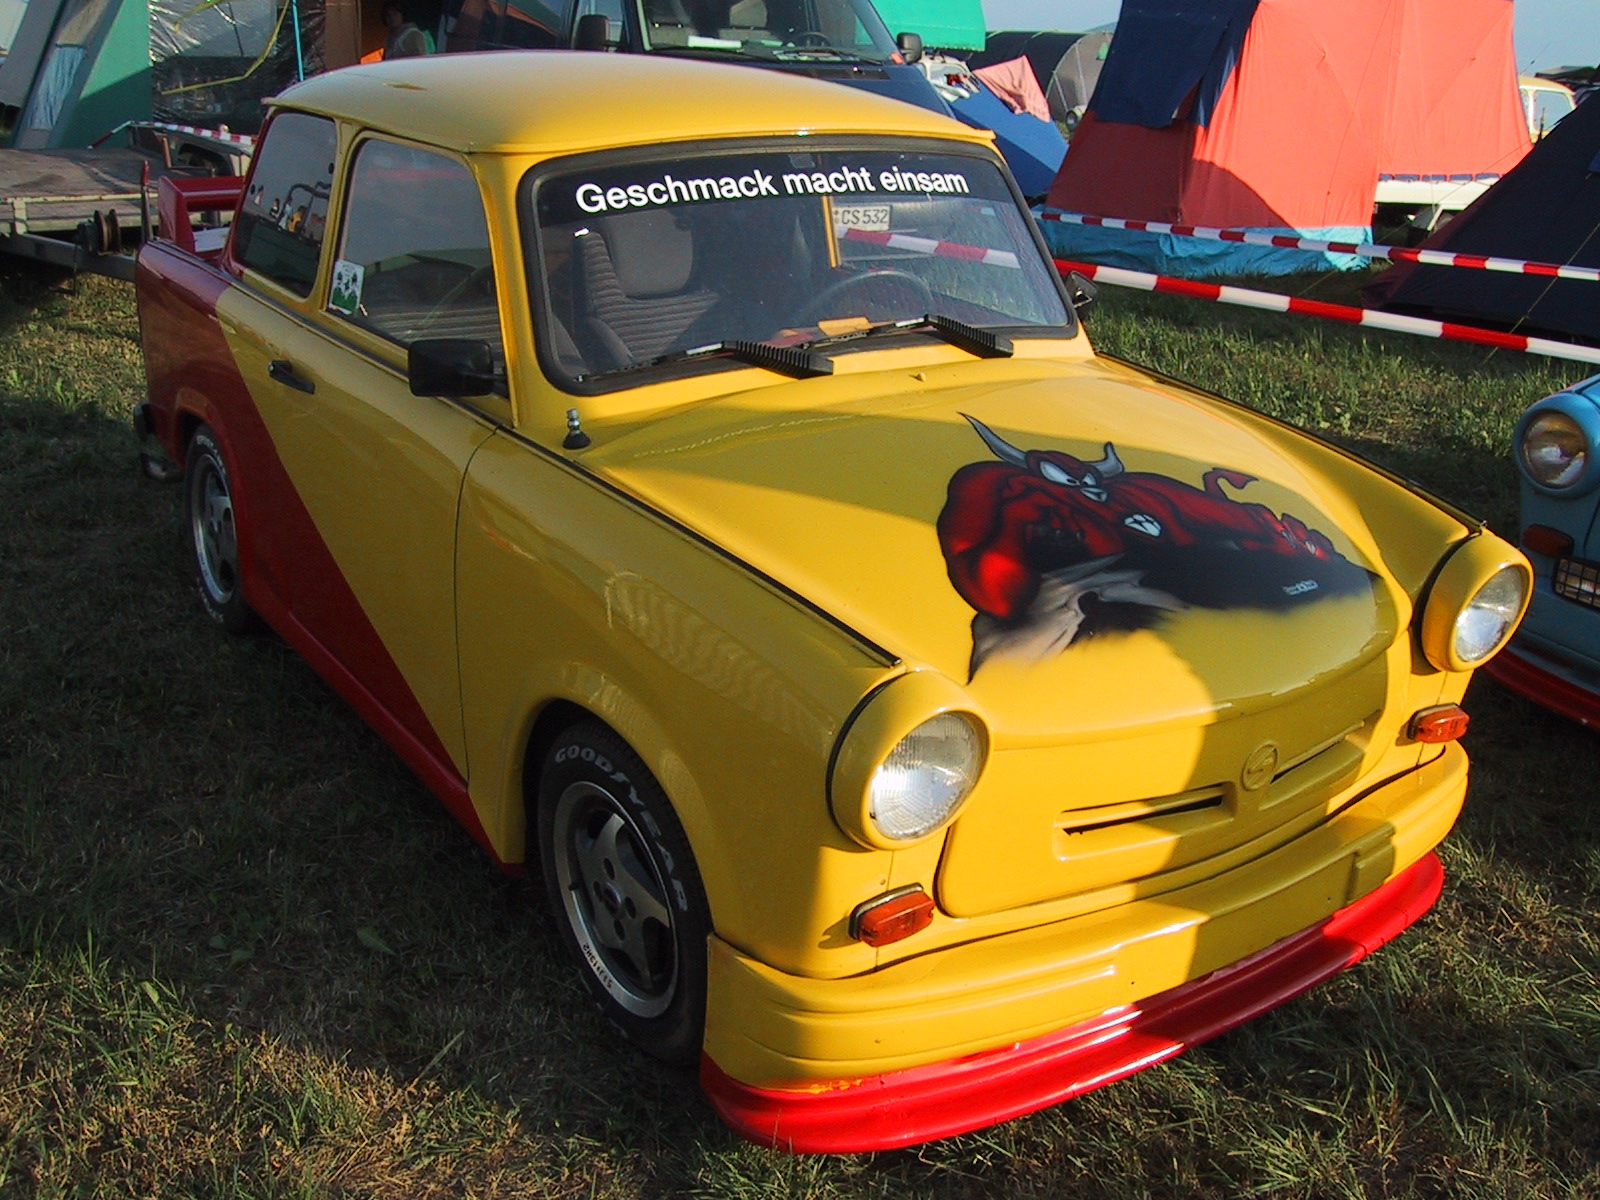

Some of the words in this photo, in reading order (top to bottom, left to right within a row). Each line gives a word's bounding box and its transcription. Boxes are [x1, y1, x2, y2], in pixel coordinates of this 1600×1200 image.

[575, 169, 779, 213] Geschmack
[782, 166, 876, 195] macht
[879, 166, 970, 194] einsam
[862, 209, 888, 224] 532
